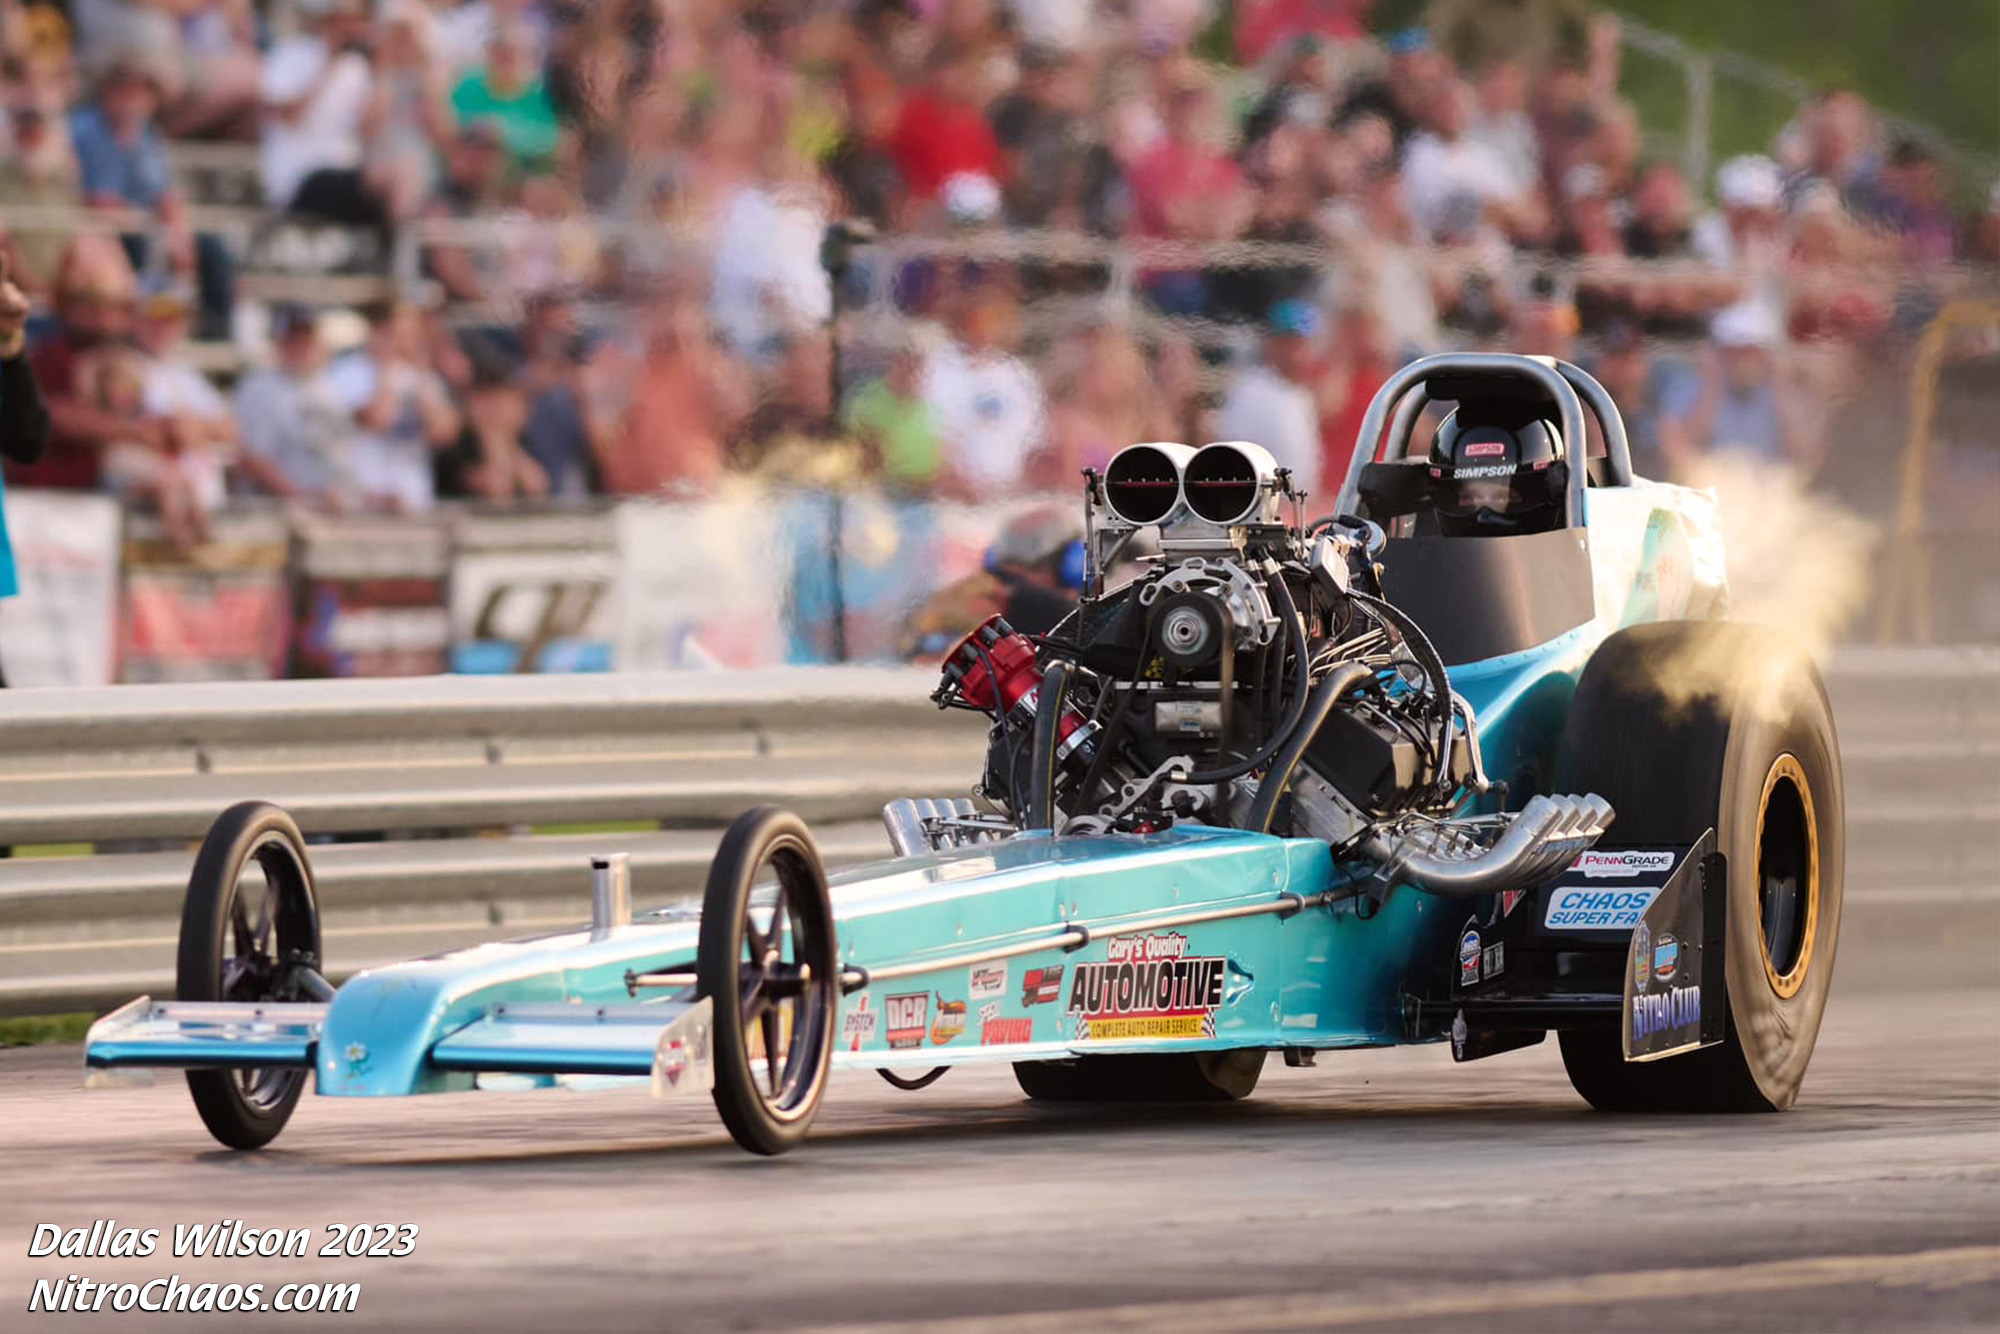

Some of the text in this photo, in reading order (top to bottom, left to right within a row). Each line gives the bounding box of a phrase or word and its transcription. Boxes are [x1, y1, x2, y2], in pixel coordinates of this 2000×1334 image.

[1453, 464, 1517, 479] SIMPSON
[1560, 892, 1651, 910] CHAOS
[1550, 911, 1611, 925] SUPER
[1108, 932, 1187, 960] Gary's Quality
[1067, 959, 1225, 1014] AUTOMOTIVE
[1092, 1018, 1199, 1039] COMPLETE AUTO REPAIR SERVICE
